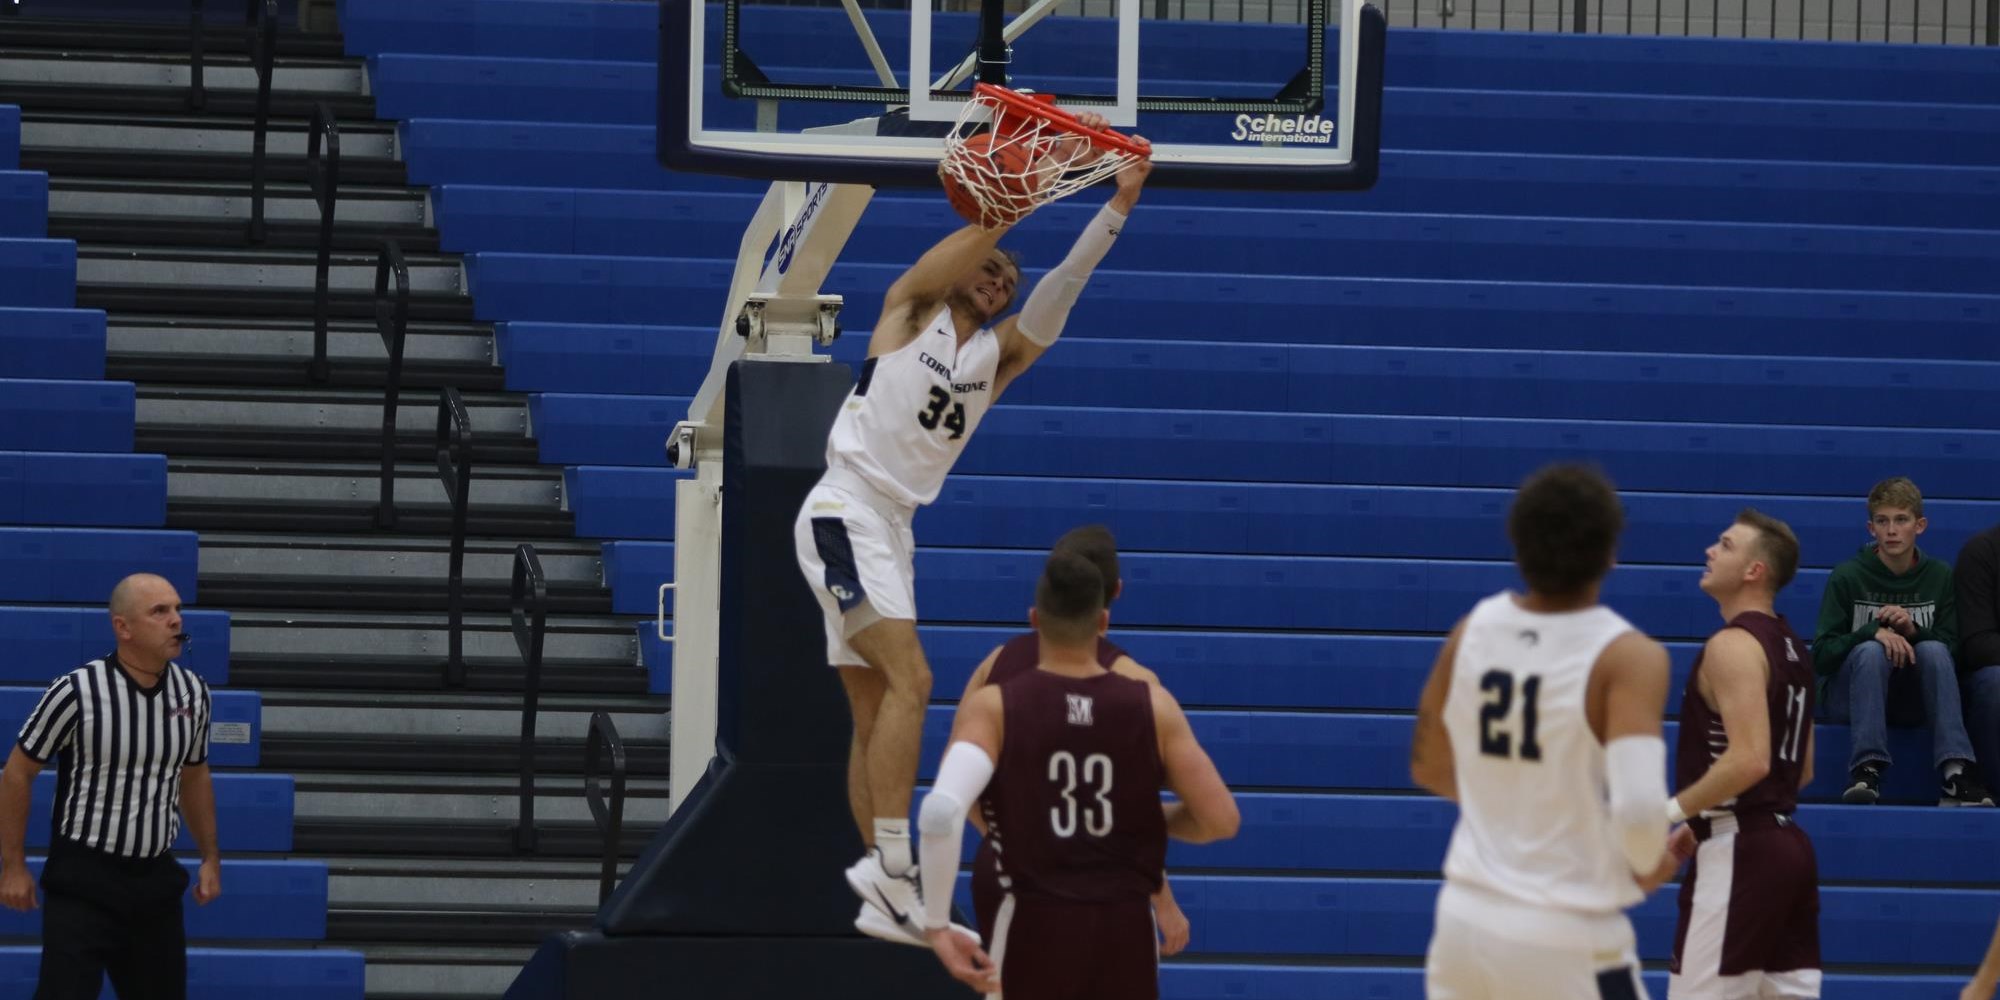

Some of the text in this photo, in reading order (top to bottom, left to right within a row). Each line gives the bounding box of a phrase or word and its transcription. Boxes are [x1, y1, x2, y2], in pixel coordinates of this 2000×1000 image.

[1232, 114, 1334, 141] Schelde
[1248, 132, 1331, 143] international
[796, 183, 828, 239] SPORTS
[918, 385, 966, 440] 34
[1480, 668, 1543, 762] 21
[1049, 751, 1113, 837] 33
